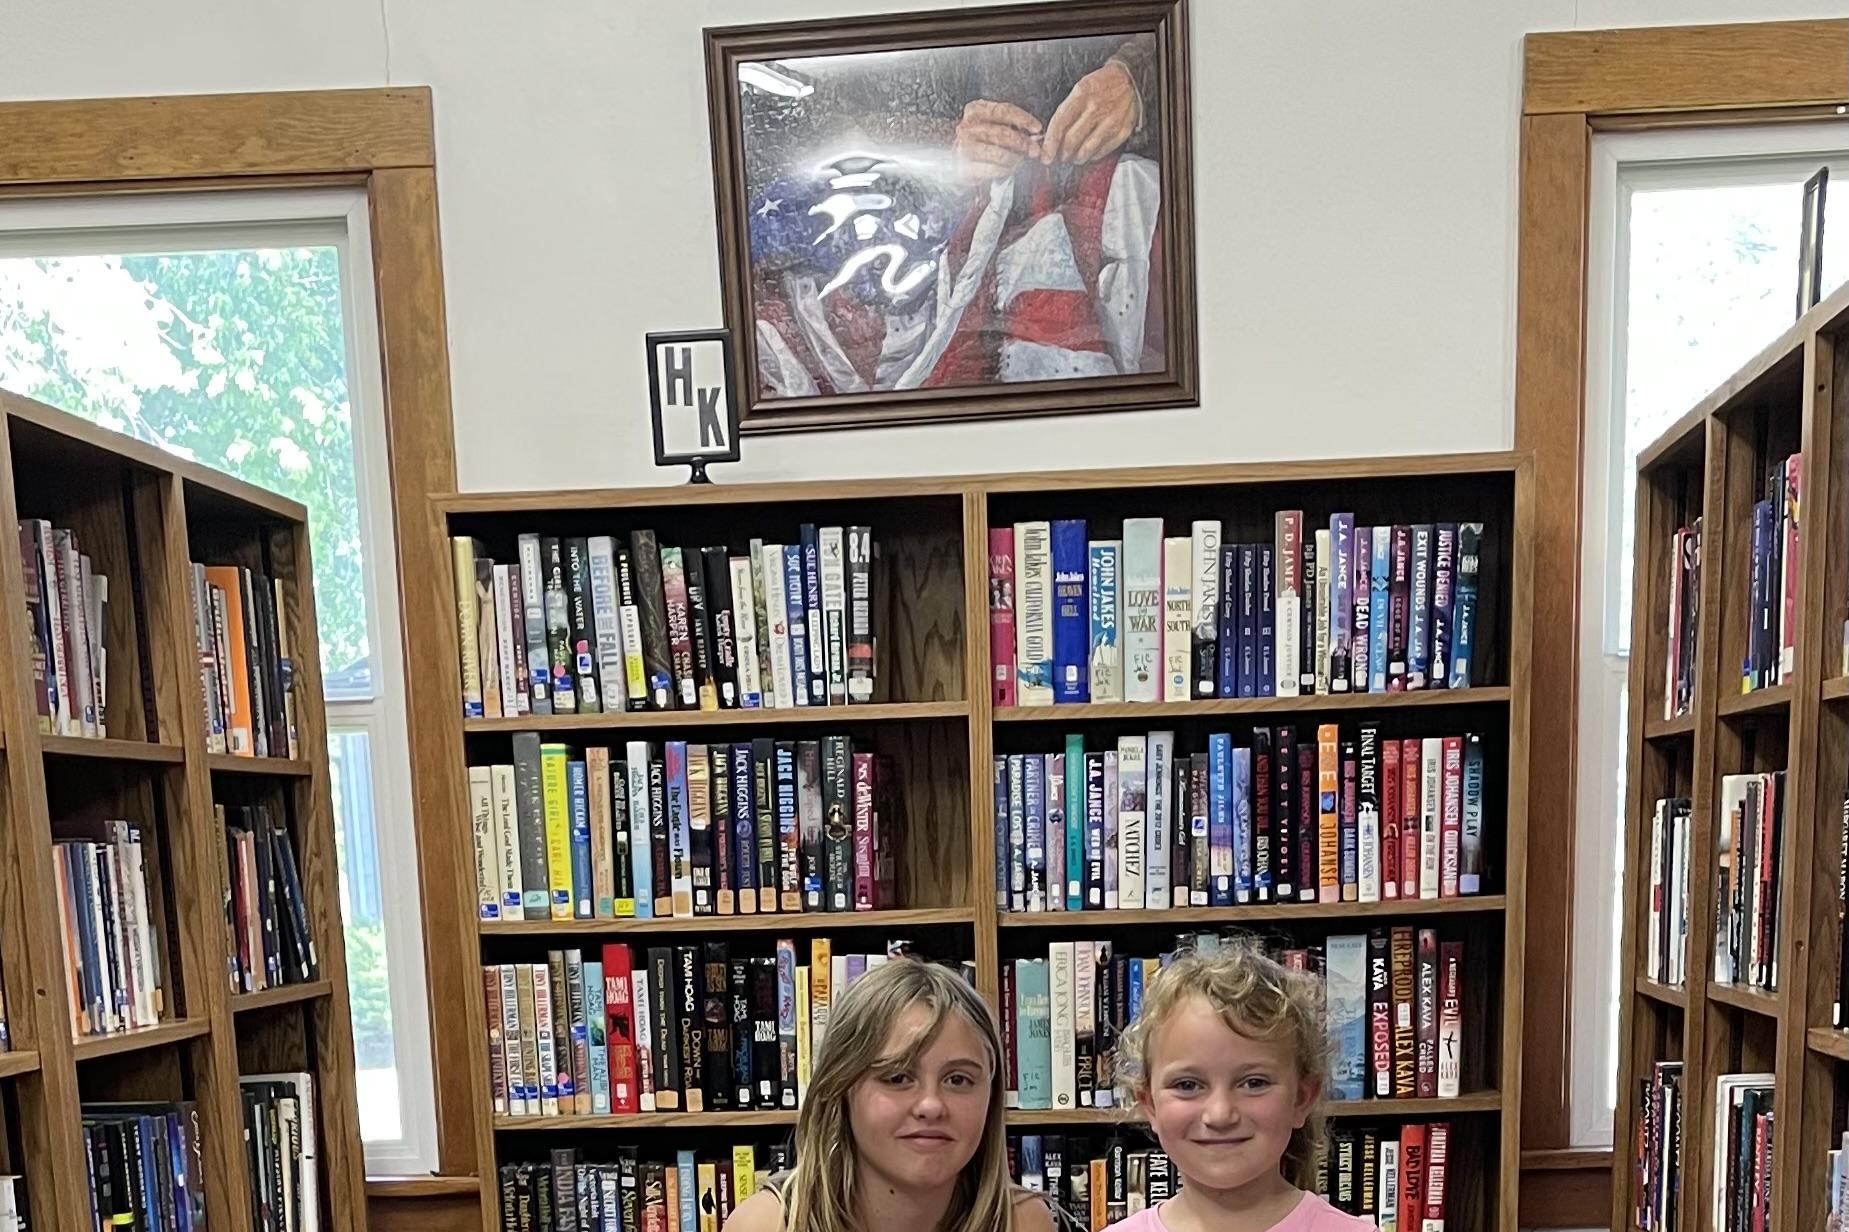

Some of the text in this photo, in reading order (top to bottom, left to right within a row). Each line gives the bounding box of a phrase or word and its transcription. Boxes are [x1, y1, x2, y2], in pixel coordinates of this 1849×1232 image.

[665, 346, 692, 406] H
[698, 387, 725, 447] K
[849, 533, 870, 567] 8.4
[1024, 529, 1047, 551] John
[1283, 517, 1294, 593] P. D. JAMES
[571, 547, 585, 630] INTO THE WATER
[591, 555, 612, 613] BEFORE
[1092, 558, 1101, 620] Homeland
[1101, 550, 1114, 629] JOHN JAKES
[1201, 528, 1215, 620] JOHN JAKES
[1305, 562, 1315, 609] PD James
[1415, 532, 1428, 611] EXIT WOUNDS
[1435, 530, 1453, 607] JUSTICE DENIED
[667, 600, 680, 645] HARPER
[676, 602, 688, 640] KAREN
[1026, 582, 1043, 633] CALIFORNIA
[1128, 590, 1159, 607] LOVE
[1166, 600, 1191, 611] NORTH
[1129, 615, 1158, 632] WAR
[1167, 620, 1191, 632] SOUTH
[600, 634, 617, 669] FALL
[1026, 636, 1043, 661] GOLD
[1134, 654, 1154, 664] FIC
[735, 749, 750, 773] JACK
[827, 757, 836, 783] HILL
[836, 742, 845, 798] REGINALD
[1216, 738, 1225, 824] PAULETTE JILES
[481, 795, 491, 835] All Things
[573, 767, 586, 828] HOMER HICKAM
[651, 764, 664, 827] JACK HIGGINS
[737, 775, 750, 819] HIGGINS
[777, 749, 796, 833] JACK HIGGINS
[1011, 759, 1023, 834] PARADISE LOST
[1026, 759, 1041, 848] PARTNER CRIME
[1089, 784, 1103, 823] JANCE
[1361, 729, 1376, 879] FINAL TARGET JOHANSEN
[1426, 759, 1435, 870] IRIS JOHANSEN ON THE RUN
[1466, 761, 1480, 837] SHADOW PLAY
[1091, 828, 1100, 847] WEB
[1444, 749, 1460, 885] IRIS JOHANSEN QUICKSAND
[1091, 862, 1100, 880] EVIL
[1125, 820, 1141, 877] NATCHEZ
[568, 963, 584, 1023] TONY HILLERMAN
[605, 977, 627, 990] TAMI
[606, 990, 629, 1004] HOAG
[683, 951, 694, 1012] TAMI HOAG
[1055, 951, 1070, 1025] ERICA JONG
[1372, 958, 1385, 990] KAVA
[1422, 962, 1433, 1029] ALEX KAVA
[501, 969, 520, 1076] TONY HILLERMAN THE FIRST
[637, 979, 648, 1041] TAMI HOAG
[755, 1021, 776, 1031] TAMI
[682, 1018, 694, 1088] DARKEST ROA
[692, 1031, 702, 1067] DOWN
[1374, 1002, 1390, 1071] EXPOSED
[1396, 1026, 1414, 1054] ALEX
[1419, 1042, 1427, 1074] CREED
[592, 1058, 600, 1081] MAN
[598, 1048, 608, 1091] THE ALIBI
[1396, 1061, 1415, 1094] KAVA
[1150, 1153, 1168, 1177] FAYE
[1363, 1135, 1374, 1209] JESSE KELLERMAN
[504, 1181, 516, 1216] Victoria
[555, 1165, 577, 1231] INDIA FAN
[622, 1190, 637, 1222] Seven
[646, 1181, 663, 1199] Silk
